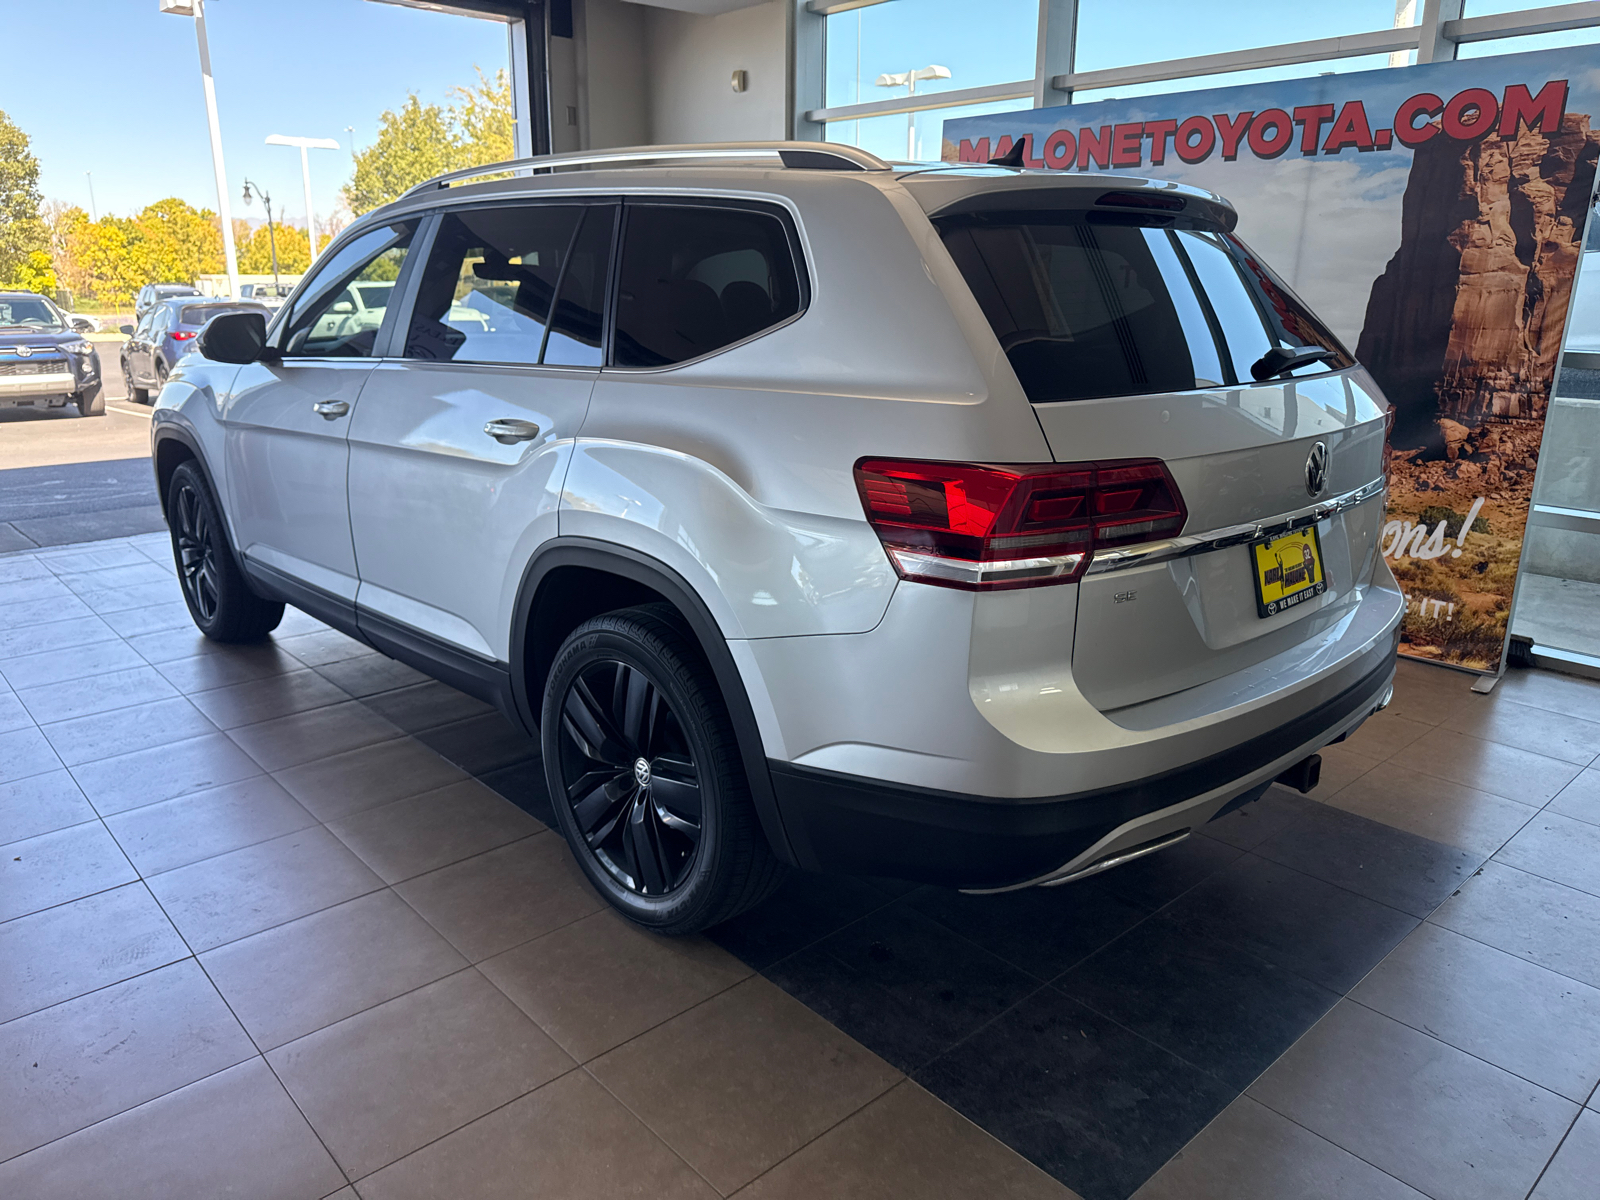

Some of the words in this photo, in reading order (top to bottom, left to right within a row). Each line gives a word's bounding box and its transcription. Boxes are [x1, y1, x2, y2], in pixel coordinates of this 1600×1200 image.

[958, 80, 1569, 170] MALONETOYOTA.COM
[1253, 494, 1361, 539] ATLAS
[1114, 589, 1137, 604] SE
[1279, 599, 1287, 610] WE
[1287, 594, 1299, 607] MAKE
[1303, 587, 1314, 600] EASY
[1420, 598, 1455, 621] IT!
[547, 640, 587, 699] YOKOHAMA
